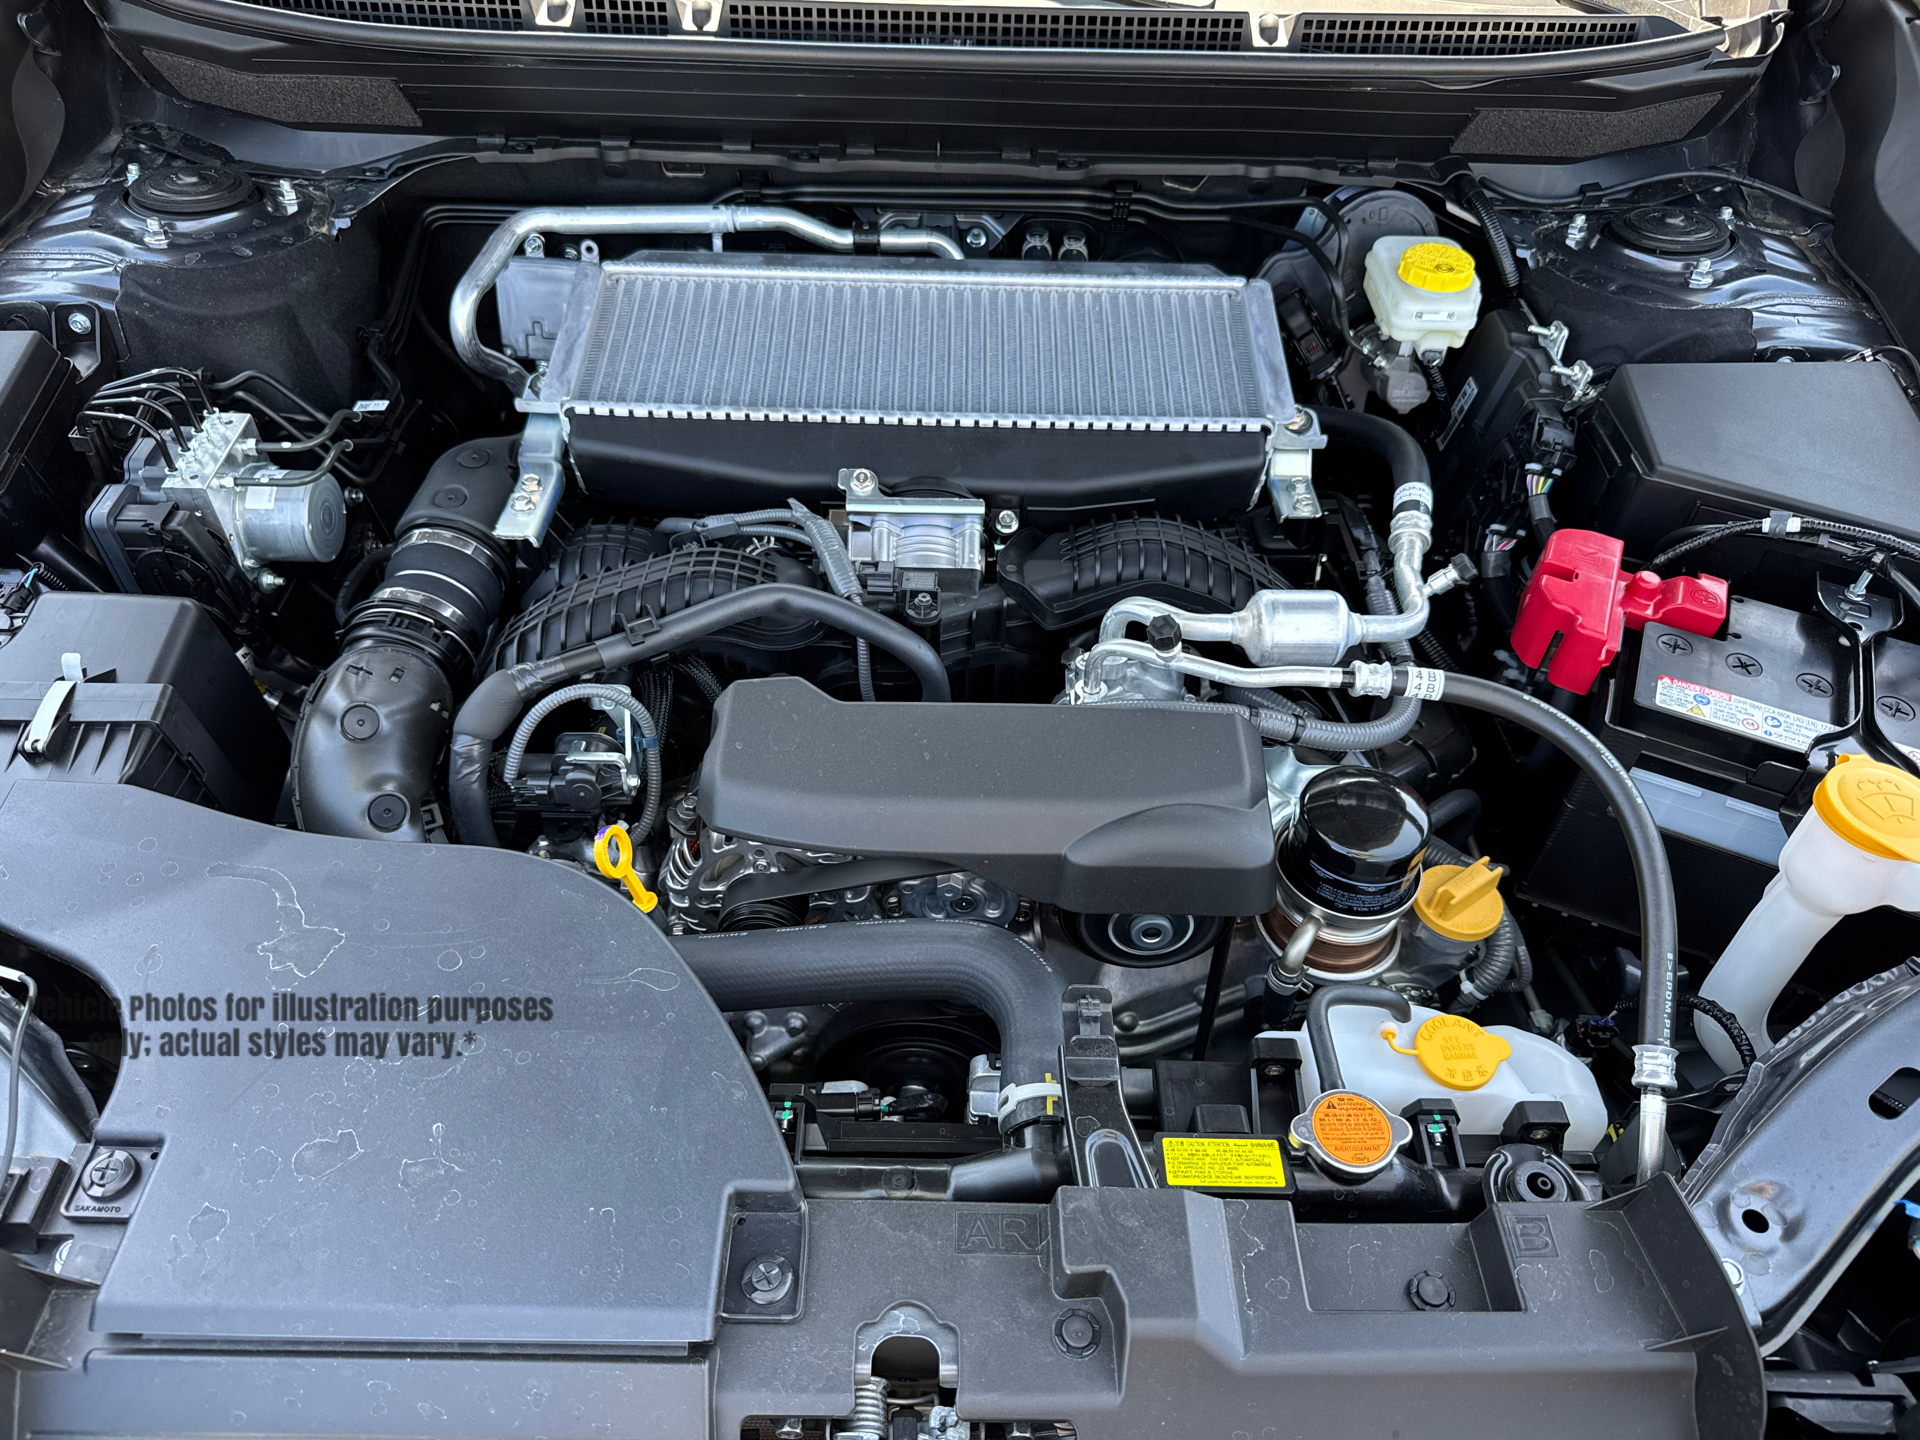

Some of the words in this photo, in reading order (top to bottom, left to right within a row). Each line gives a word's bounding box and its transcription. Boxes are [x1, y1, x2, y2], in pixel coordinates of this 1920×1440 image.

[1414, 683, 1421, 691] 4
[1426, 684, 1435, 693] B
[1673, 680, 1699, 692] DANGER
[1704, 688, 1729, 701] POISON
[1764, 707, 1776, 715] CCA
[1420, 1017, 1484, 1041] COOLANT
[74, 1205, 121, 1213] SAKAMOTO
[961, 1213, 1033, 1250] AR
[1515, 1219, 1551, 1253] B
